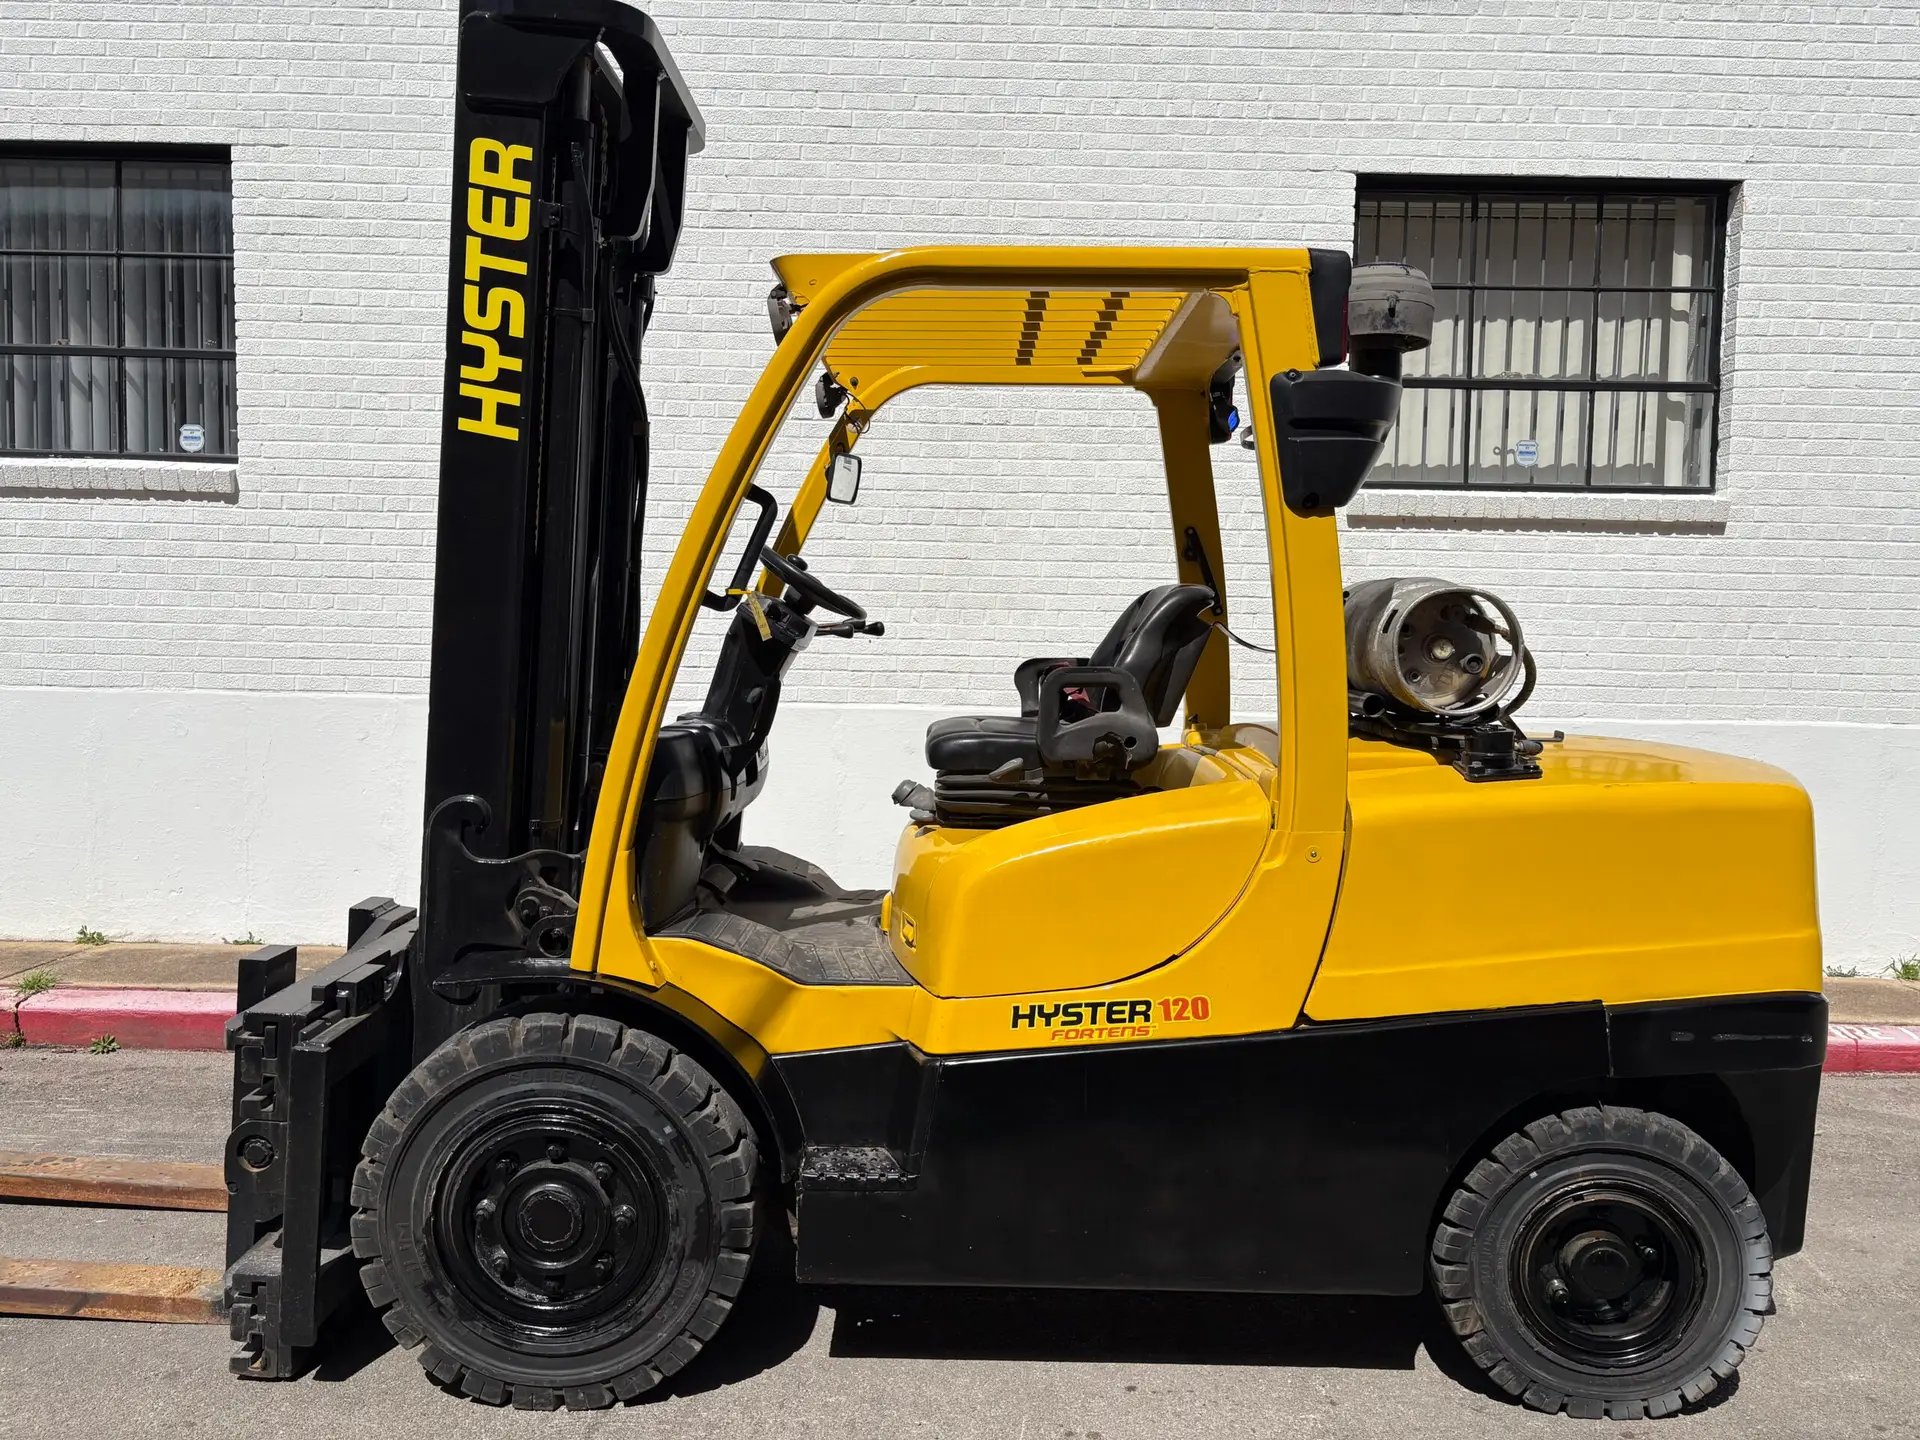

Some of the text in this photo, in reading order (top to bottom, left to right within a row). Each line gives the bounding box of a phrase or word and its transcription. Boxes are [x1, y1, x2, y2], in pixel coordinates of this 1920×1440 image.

[458, 137, 533, 441] HYSTER
[1011, 996, 1210, 1028] HYSTER 120
[1051, 1025, 1151, 1040] FORTENS
